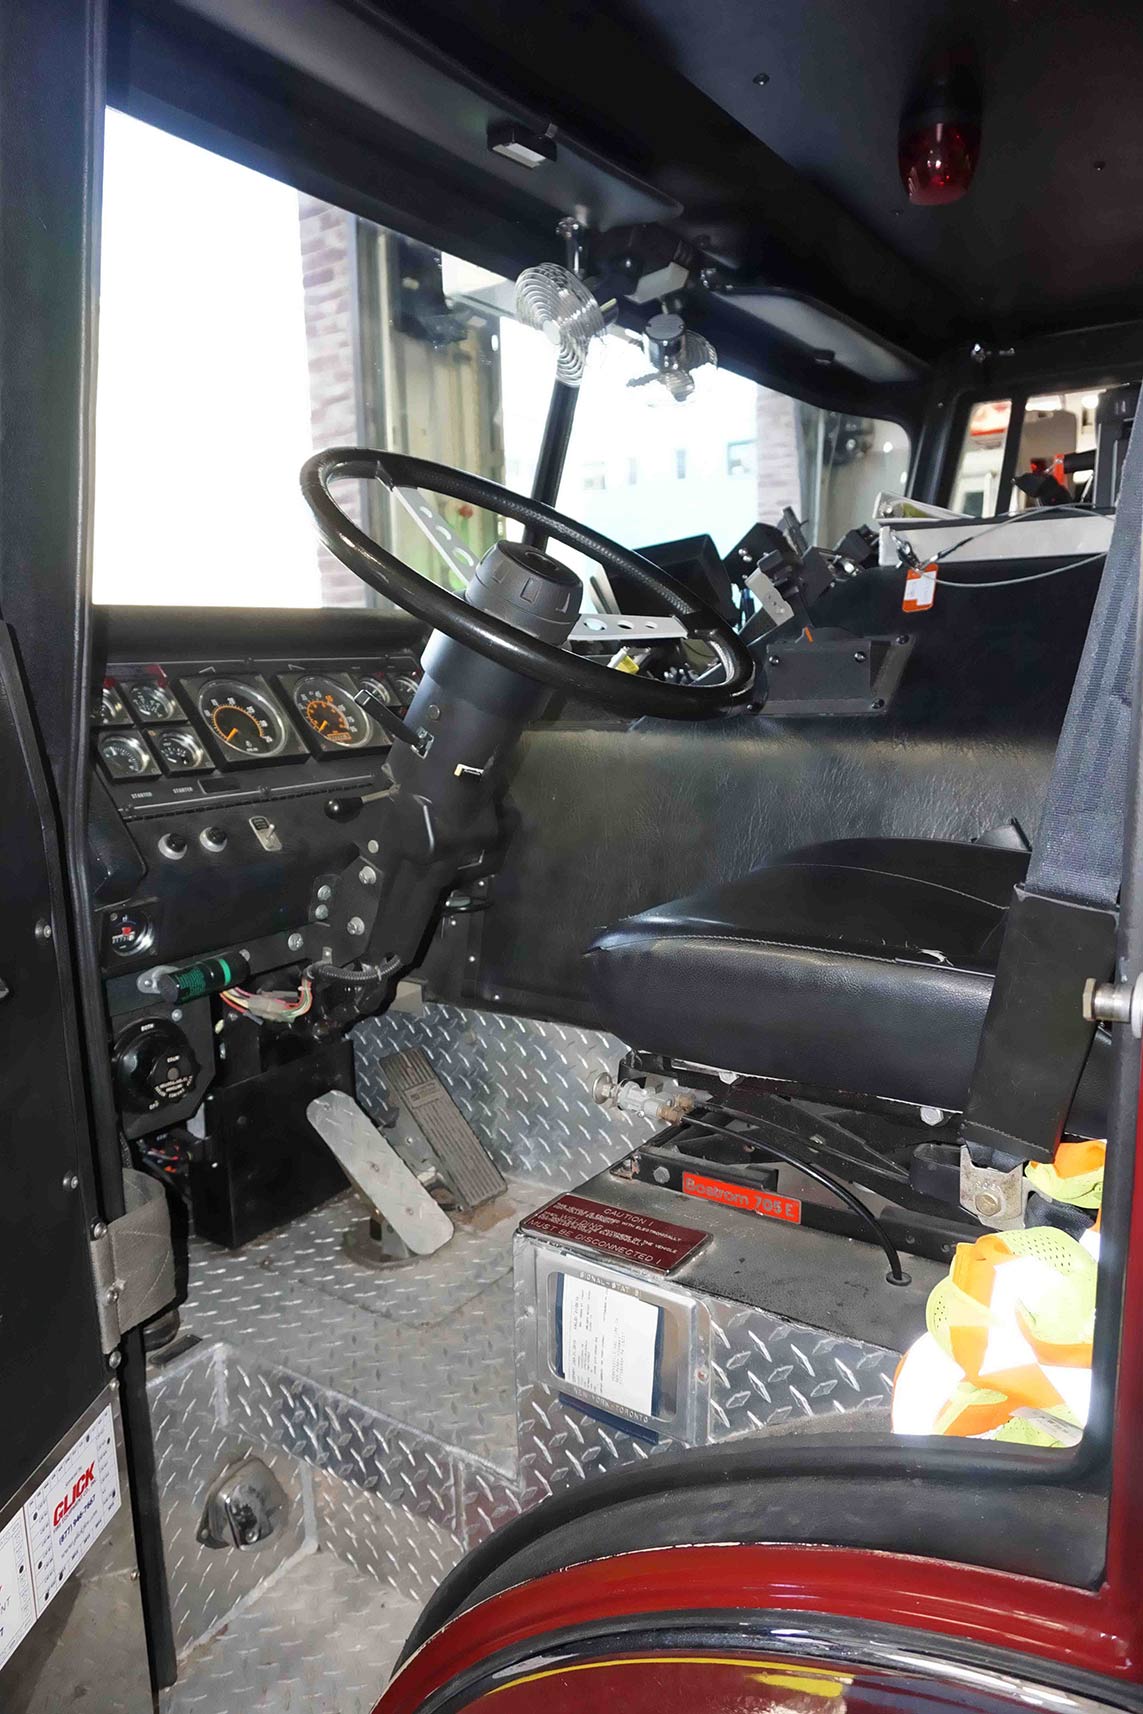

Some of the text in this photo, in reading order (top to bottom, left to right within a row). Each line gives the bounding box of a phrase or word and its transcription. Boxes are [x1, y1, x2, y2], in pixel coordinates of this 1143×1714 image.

[603, 1208, 647, 1225] CAUTION
[685, 1178, 795, 1217] Bostrom 705 E
[528, 1219, 557, 1231] MUST
[558, 1229, 573, 1237] BE
[575, 1234, 654, 1262] DISCONNECTED
[53, 1460, 95, 1527] GLICK
